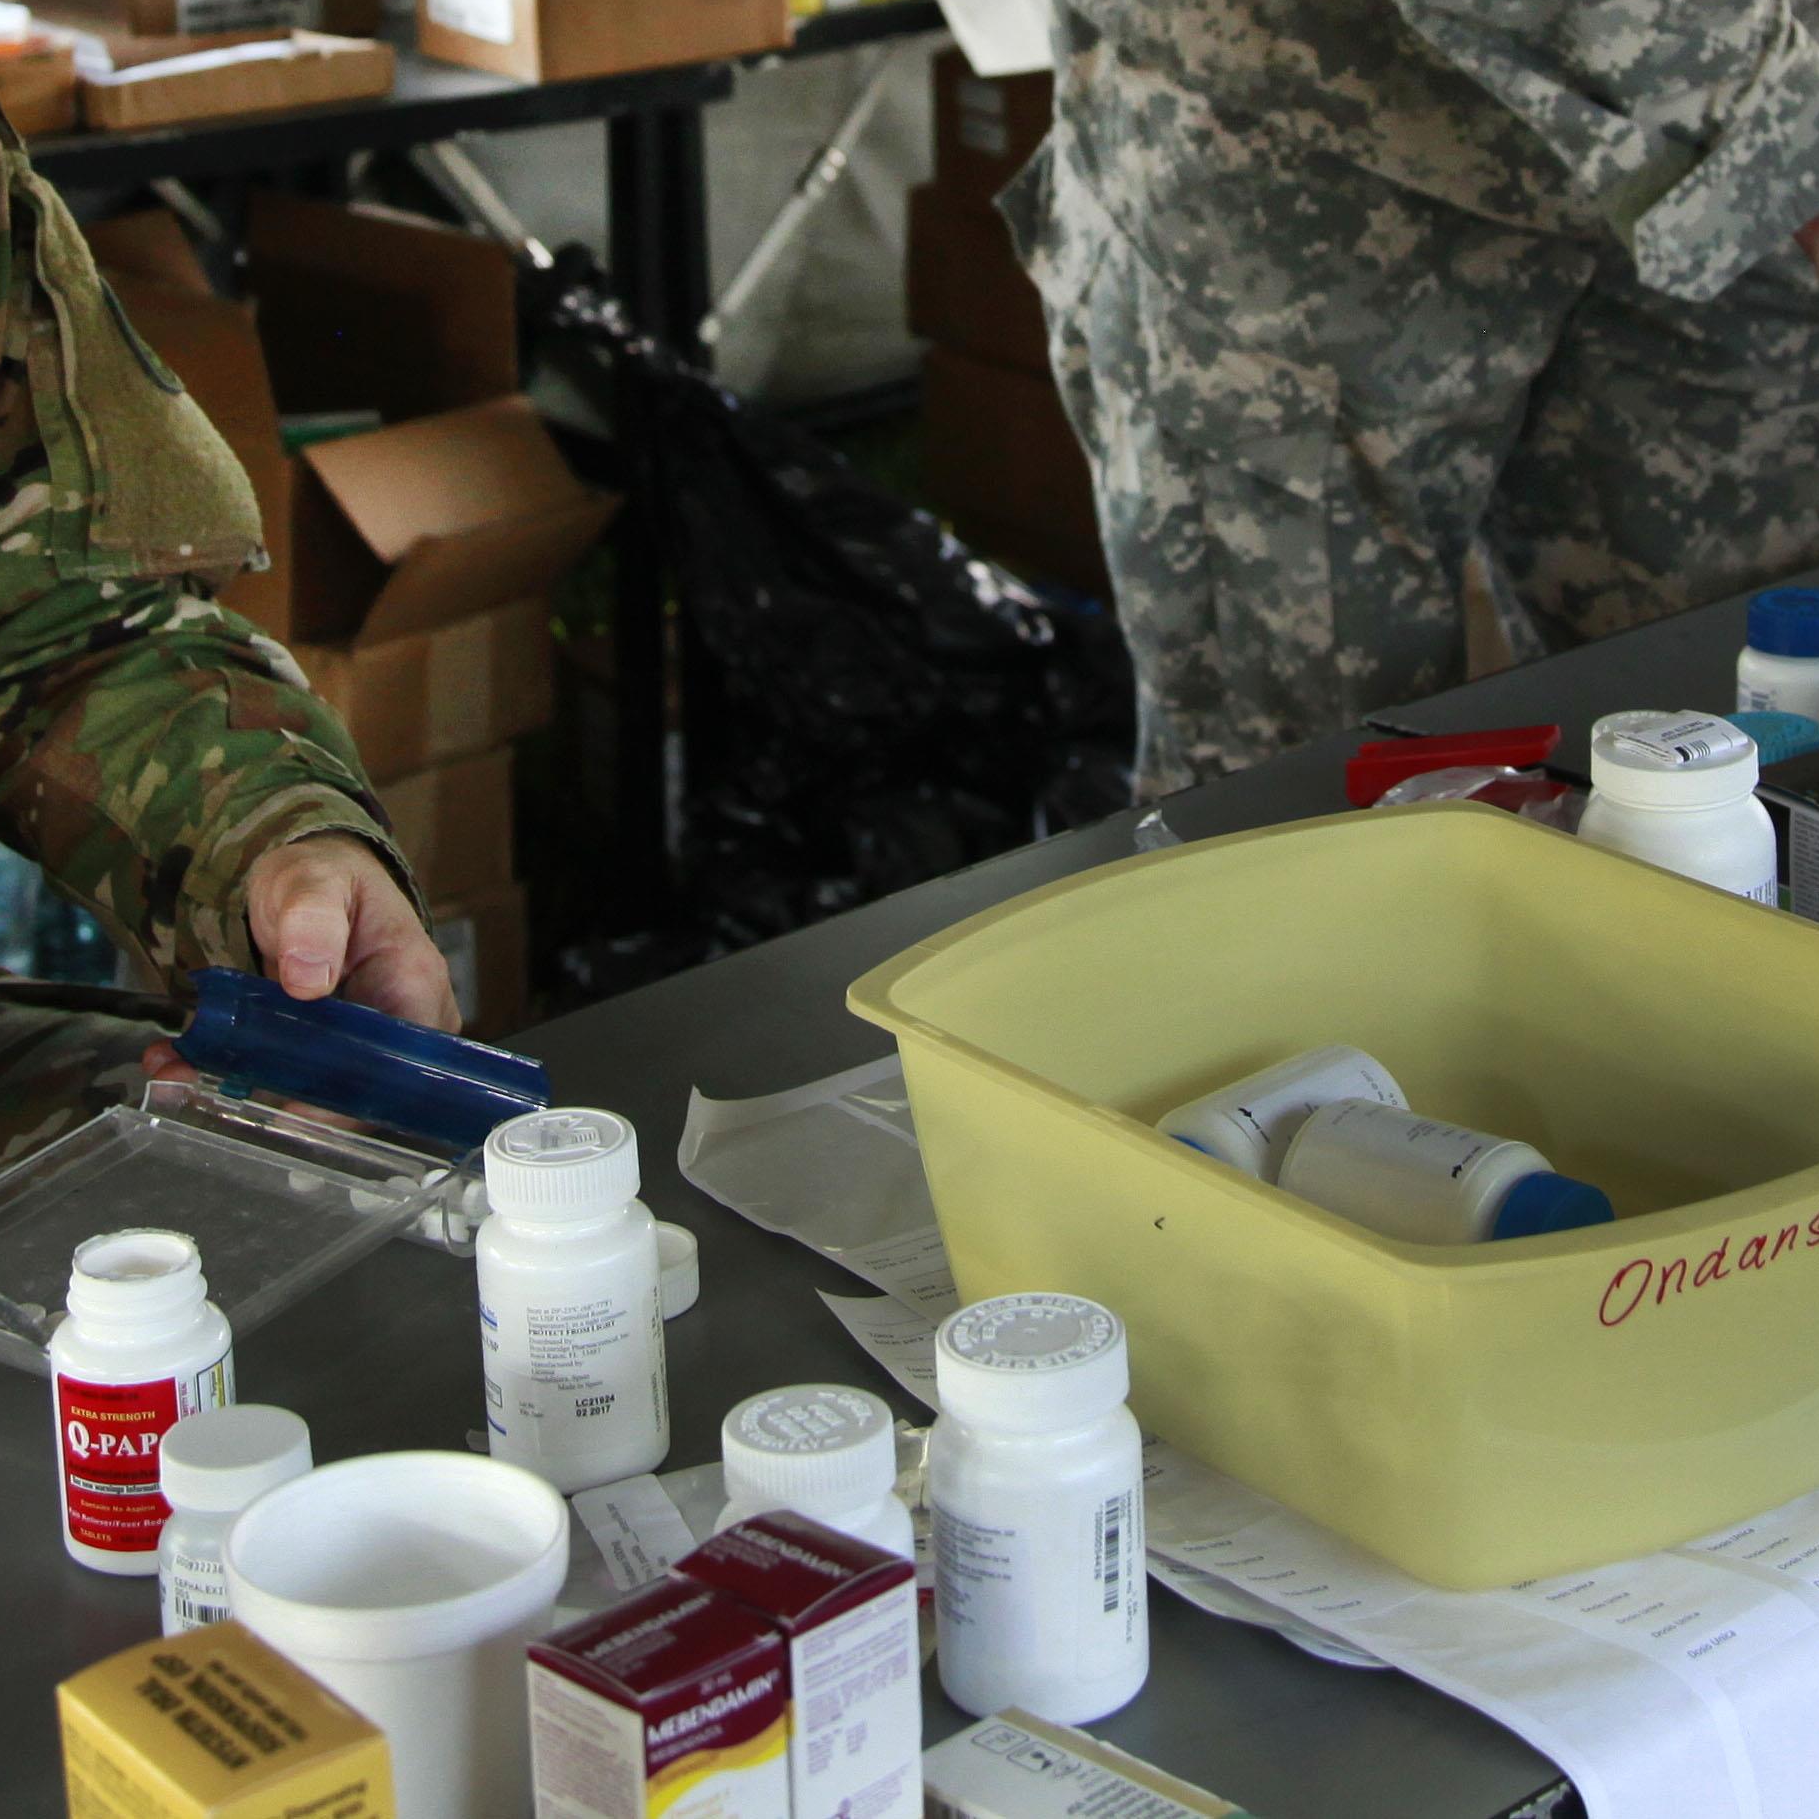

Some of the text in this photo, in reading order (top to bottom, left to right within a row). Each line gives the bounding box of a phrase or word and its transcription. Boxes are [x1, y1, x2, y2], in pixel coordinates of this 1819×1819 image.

[566, 1327, 590, 1335] FROM
[591, 1321, 614, 1332] LIGHT
[71, 1406, 156, 1422] EXTRA STRENGTH
[576, 1405, 612, 1417] 02 2017
[68, 1420, 158, 1459] Q-PAP
[80, 1499, 156, 1513] Contains No Aspirin
[82, 1514, 141, 1528] Reliever/Fever
[80, 1527, 112, 1542] TABLETS
[1687, 1629, 1737, 1660] Dosis Unica
[647, 1674, 775, 1744] MEBENDAMIN
